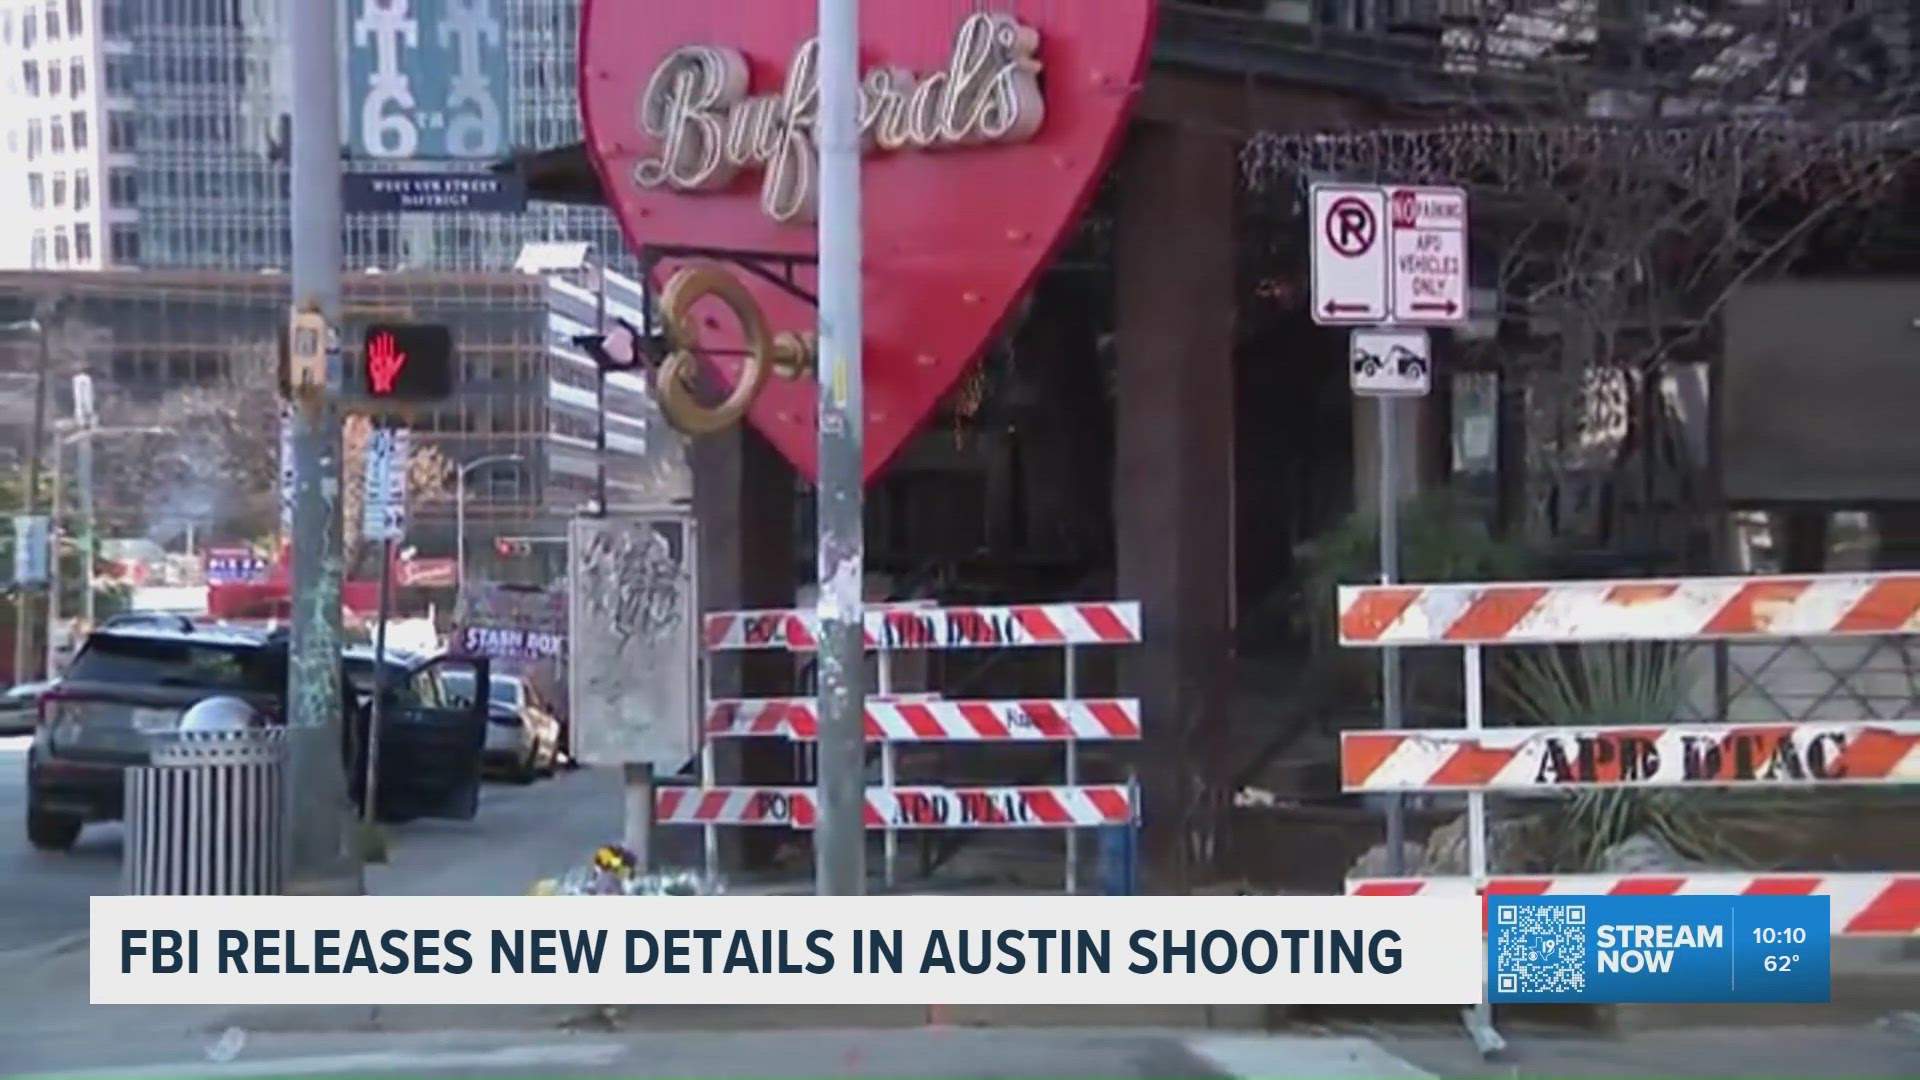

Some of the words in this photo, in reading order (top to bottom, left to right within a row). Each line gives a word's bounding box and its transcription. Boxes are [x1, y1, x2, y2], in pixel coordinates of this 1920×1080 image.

[634, 12, 1042, 222] Bufrd's
[1400, 254, 1458, 275] VEHICLES
[1412, 276, 1446, 296] ONLY
[1535, 734, 1661, 784] APD
[1679, 731, 1849, 783] DTAC
[892, 791, 949, 824] APD
